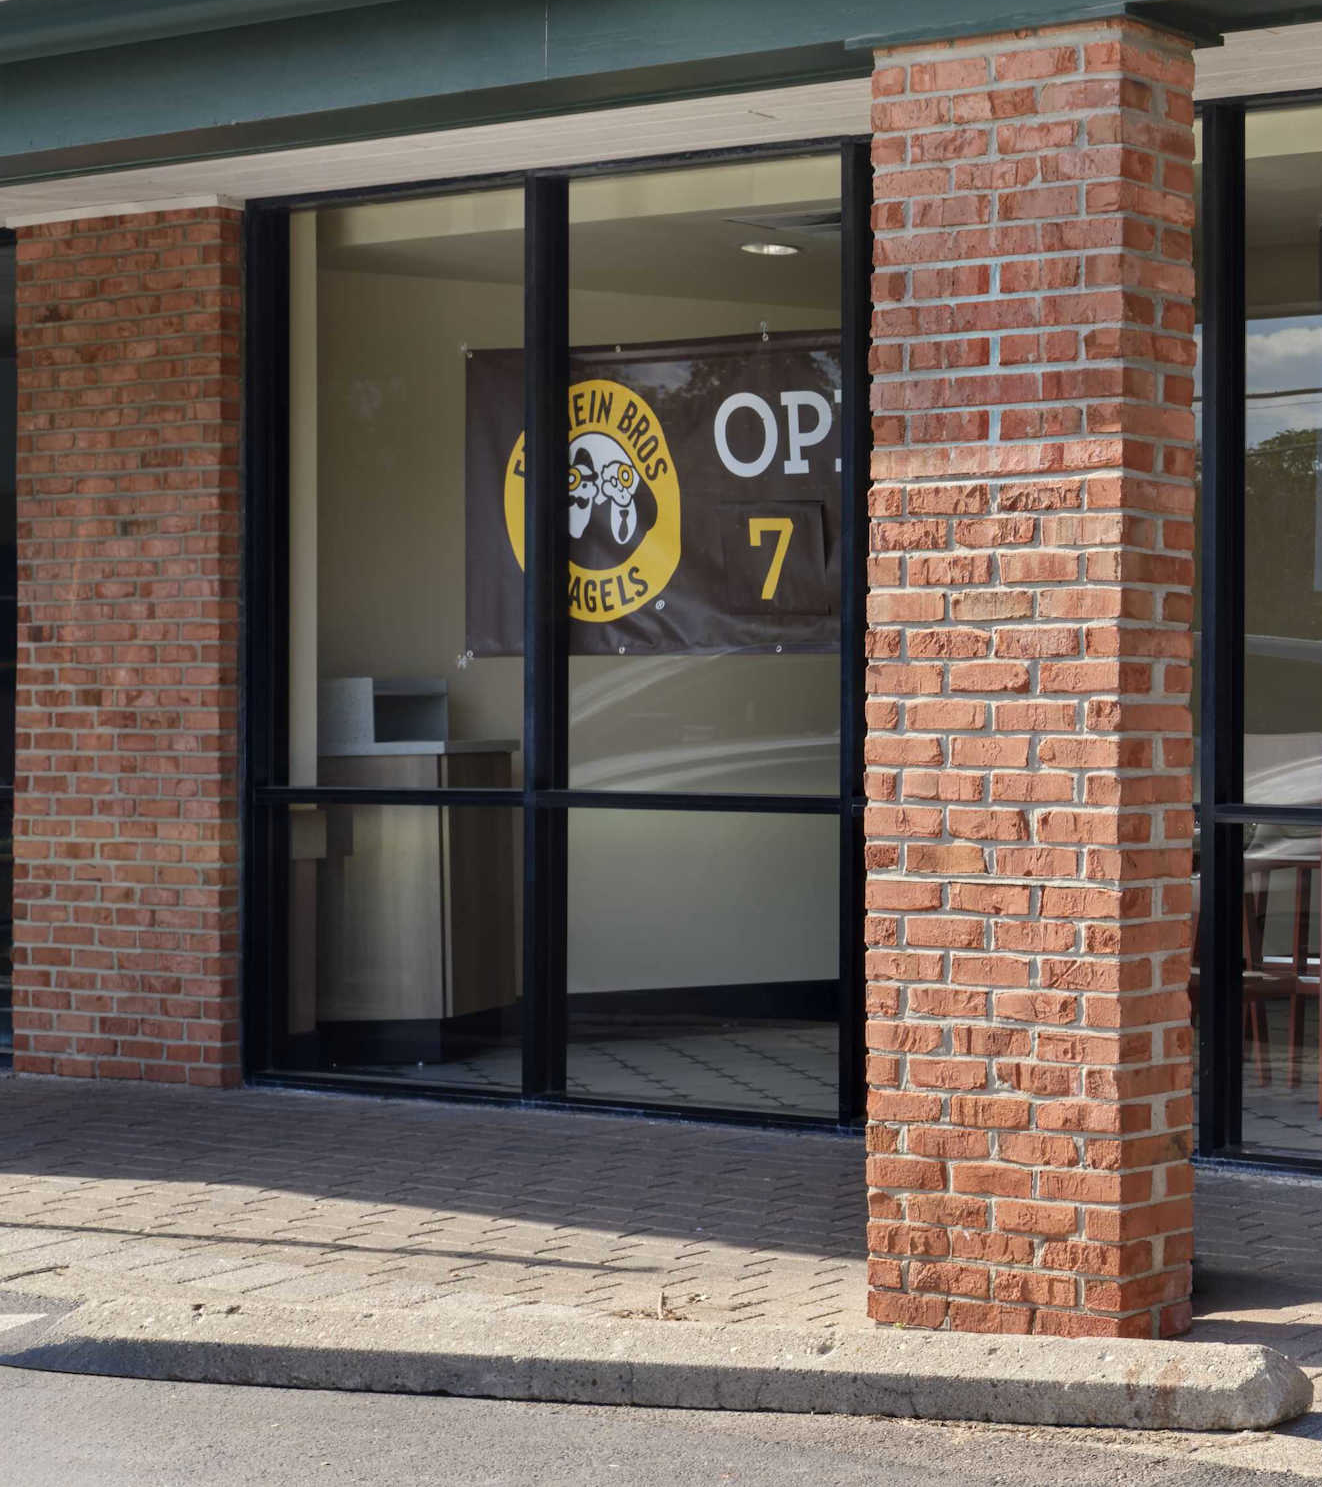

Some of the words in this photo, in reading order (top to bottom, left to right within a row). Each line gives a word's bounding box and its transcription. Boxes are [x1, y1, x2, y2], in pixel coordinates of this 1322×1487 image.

[617, 399, 668, 482] BROS
[713, 389, 841, 478] OP
[568, 566, 649, 613] AGELS
[748, 517, 794, 601] 7
